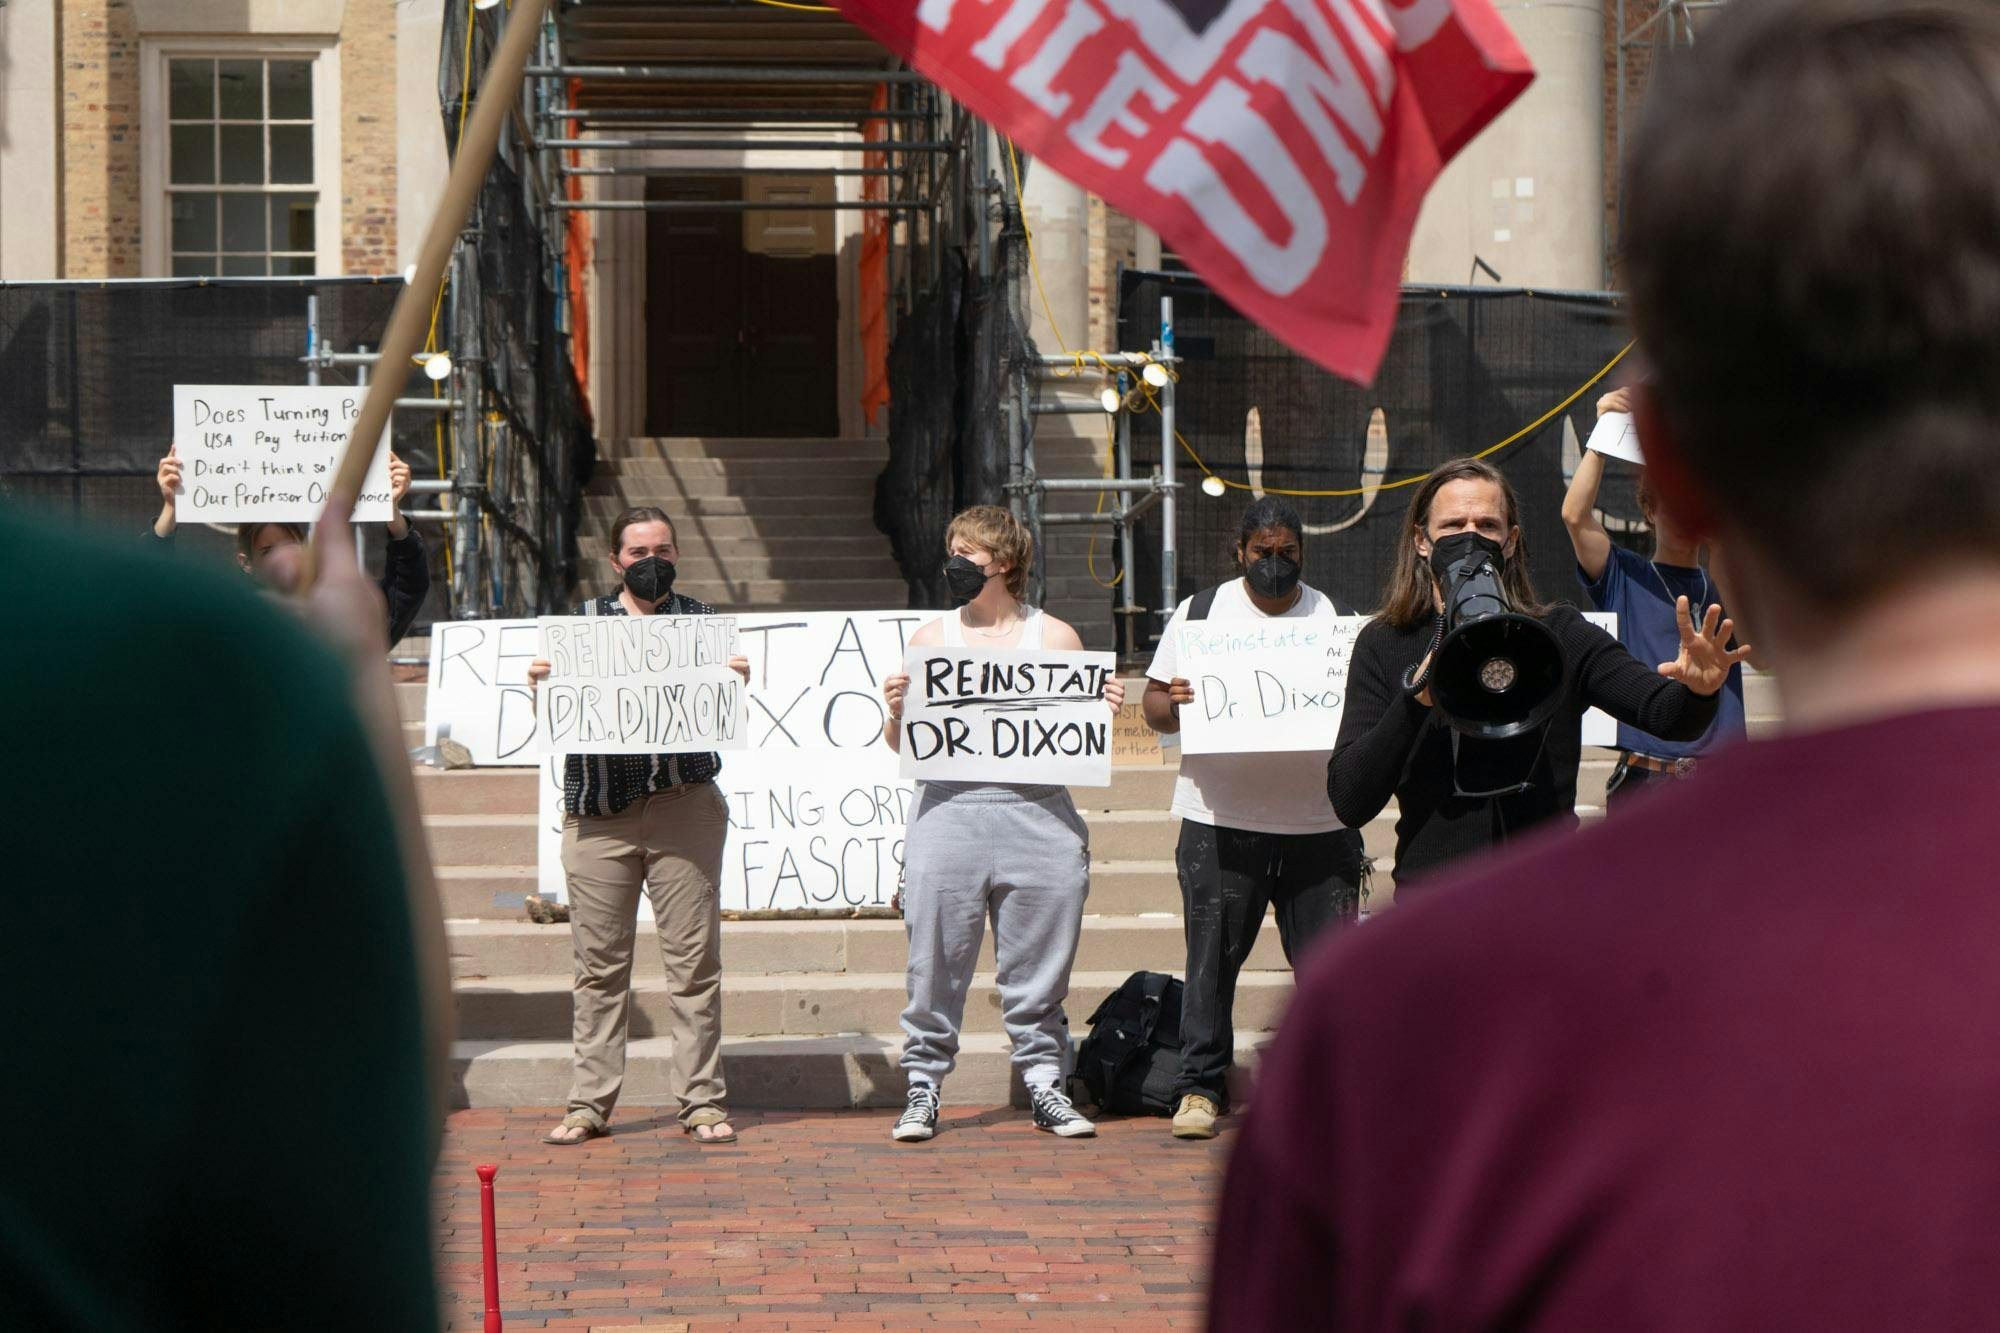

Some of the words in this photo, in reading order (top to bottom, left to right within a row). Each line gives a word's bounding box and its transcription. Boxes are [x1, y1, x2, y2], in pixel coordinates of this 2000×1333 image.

[194, 399, 245, 426] Does
[258, 398, 329, 427] Turning
[342, 398, 360, 419] Po
[204, 432, 232, 449] USA
[255, 431, 280, 453] Pay
[294, 429, 347, 443] tuition
[195, 459, 250, 476] Didn't
[261, 460, 304, 475] think
[193, 485, 228, 508] Our
[235, 482, 302, 508] Professor
[307, 481, 331, 503] Ou
[545, 617, 739, 679] REINSTATE
[1181, 625, 1318, 659] Reinstate
[925, 657, 1115, 699] REINSTATE
[1201, 674, 1245, 722] Dr.
[1254, 670, 1342, 718] Dixo
[907, 715, 983, 762] DR.
[992, 717, 1107, 759] DIXON
[725, 785, 825, 830] ING
